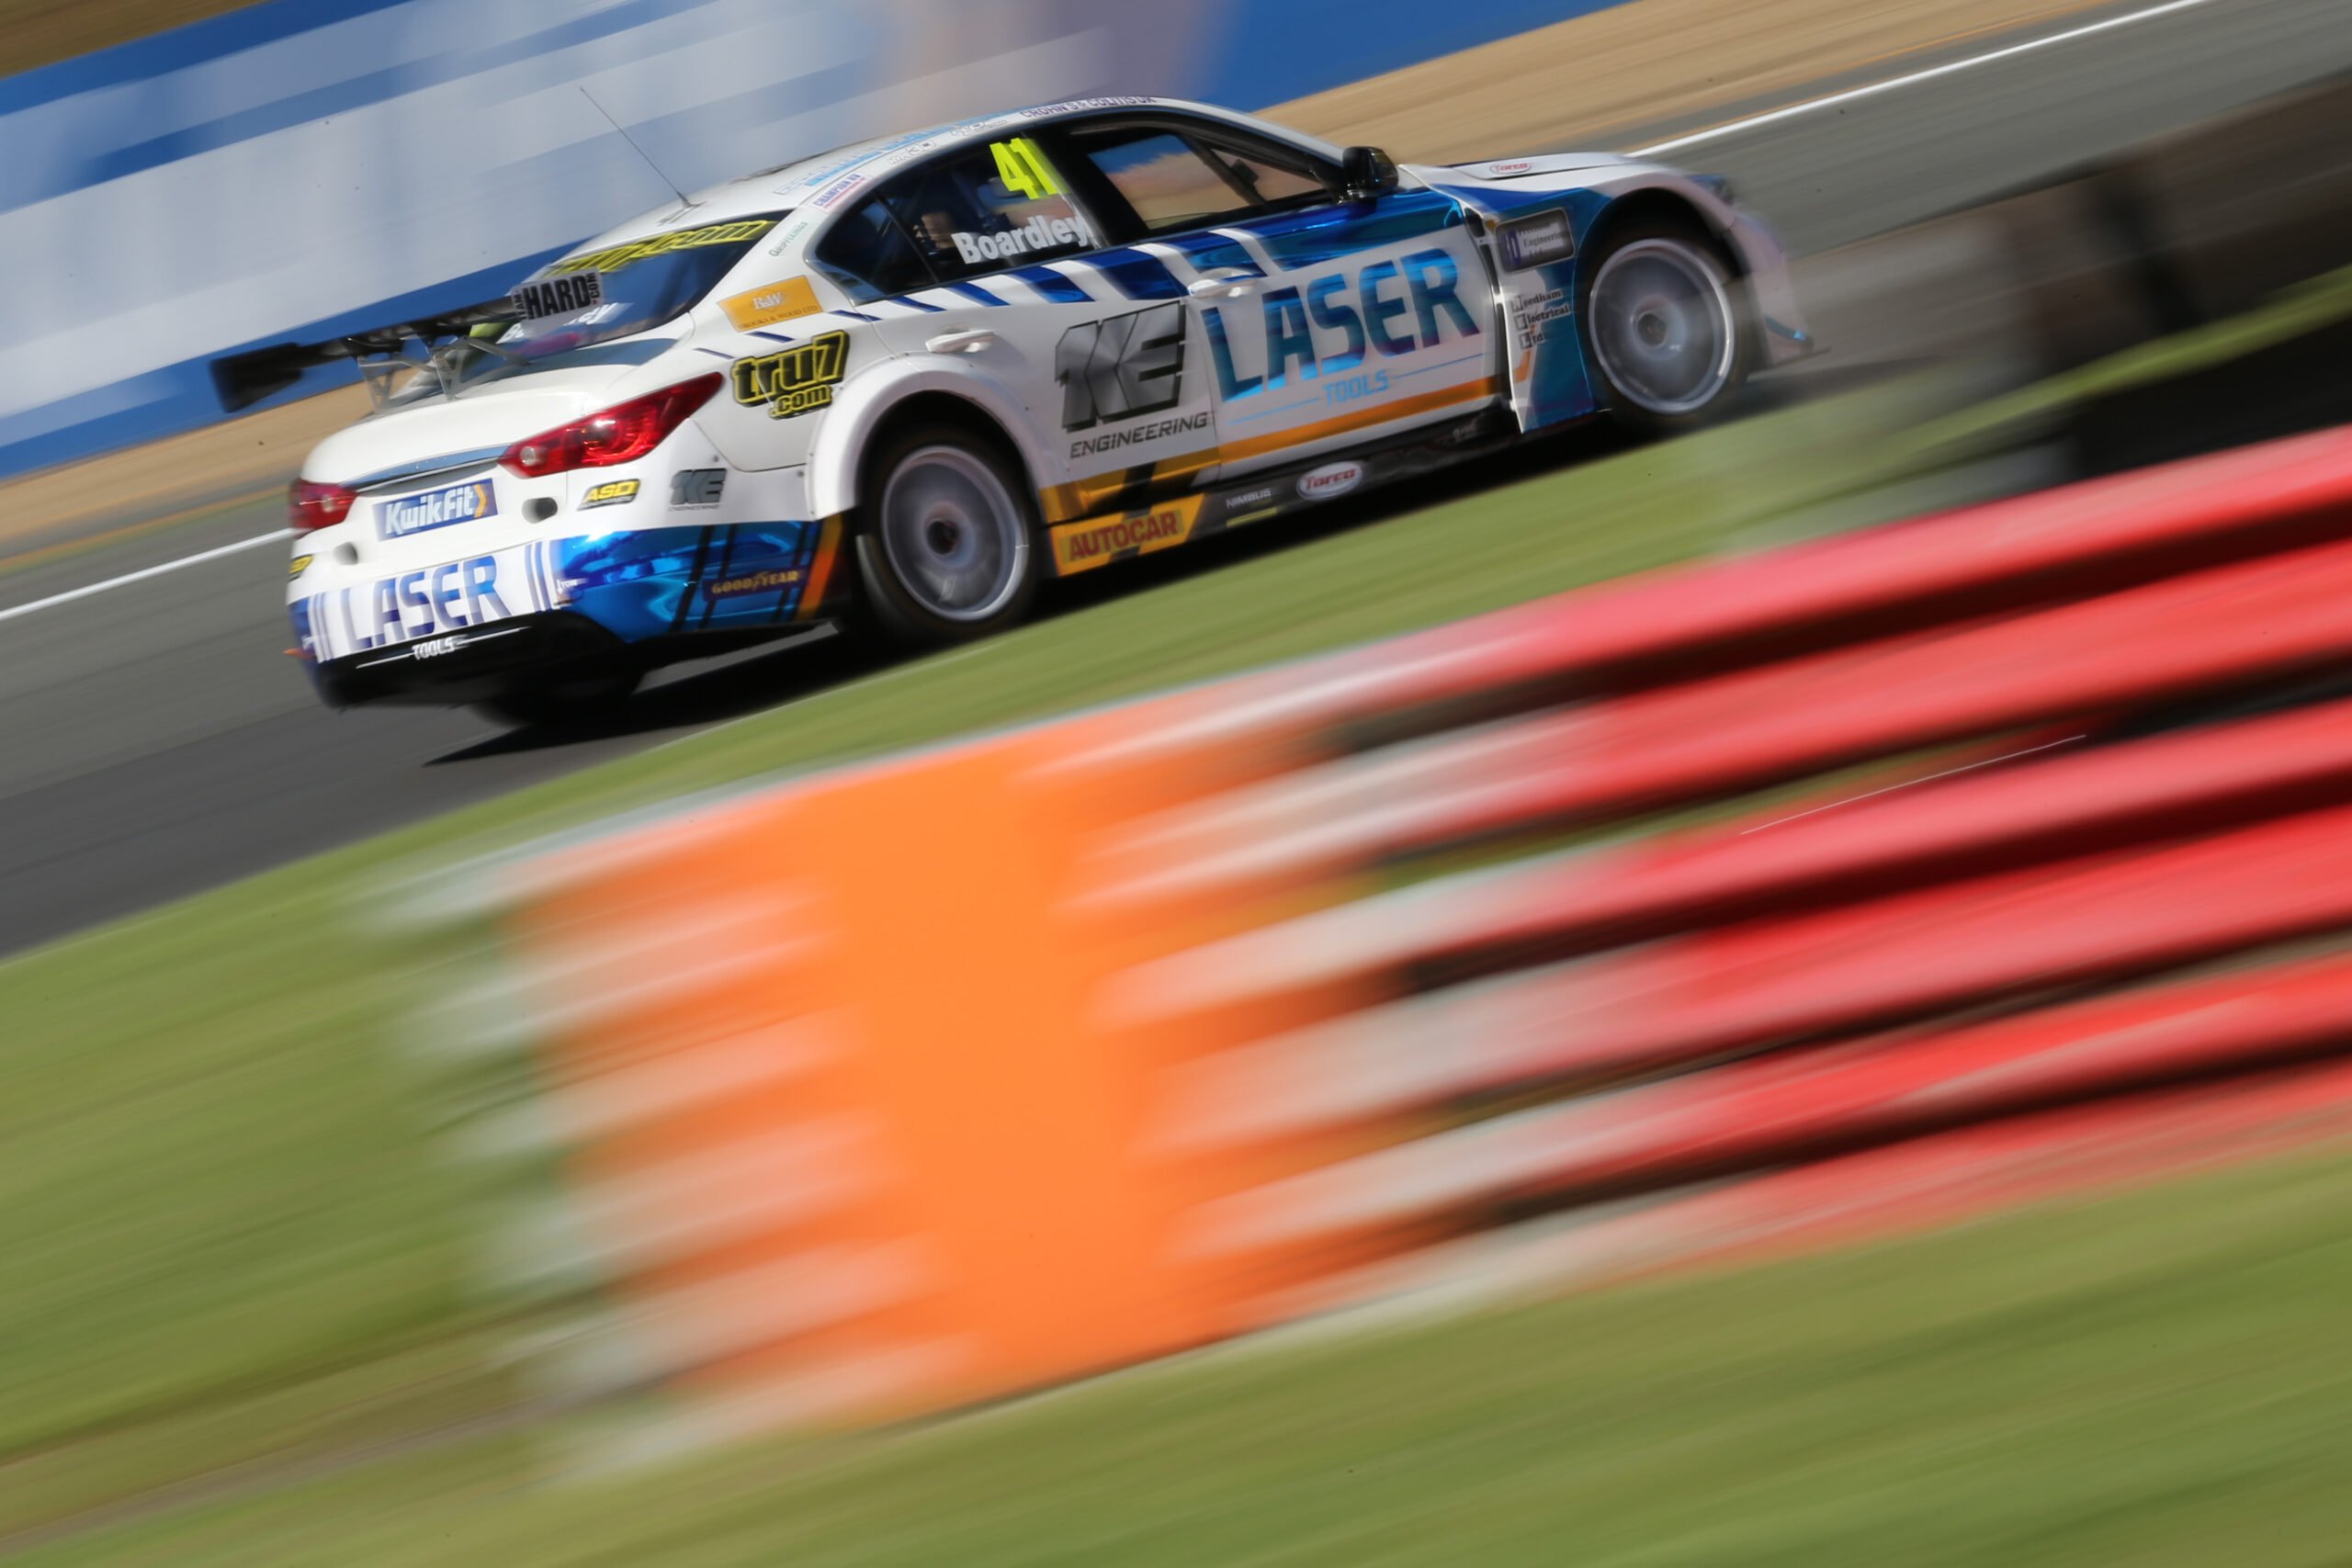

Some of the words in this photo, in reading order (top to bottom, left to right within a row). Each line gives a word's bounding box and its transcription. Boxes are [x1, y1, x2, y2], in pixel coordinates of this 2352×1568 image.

[989, 138, 1058, 199] 41
[950, 214, 1090, 265] Boardley
[523, 275, 591, 320] HARD
[1201, 248, 1480, 402] LASER
[730, 330, 850, 407] tru7
[1323, 370, 1389, 405] TOOLS
[1069, 412, 1208, 458] ENGINEERING
[582, 479, 639, 503] ASD
[1226, 487, 1272, 509] NIMBUS
[1069, 511, 1179, 562] AUTOCAR
[341, 555, 512, 654] LASER
[710, 569, 799, 594] GOODYEAR
[412, 636, 456, 660] TOOLS
